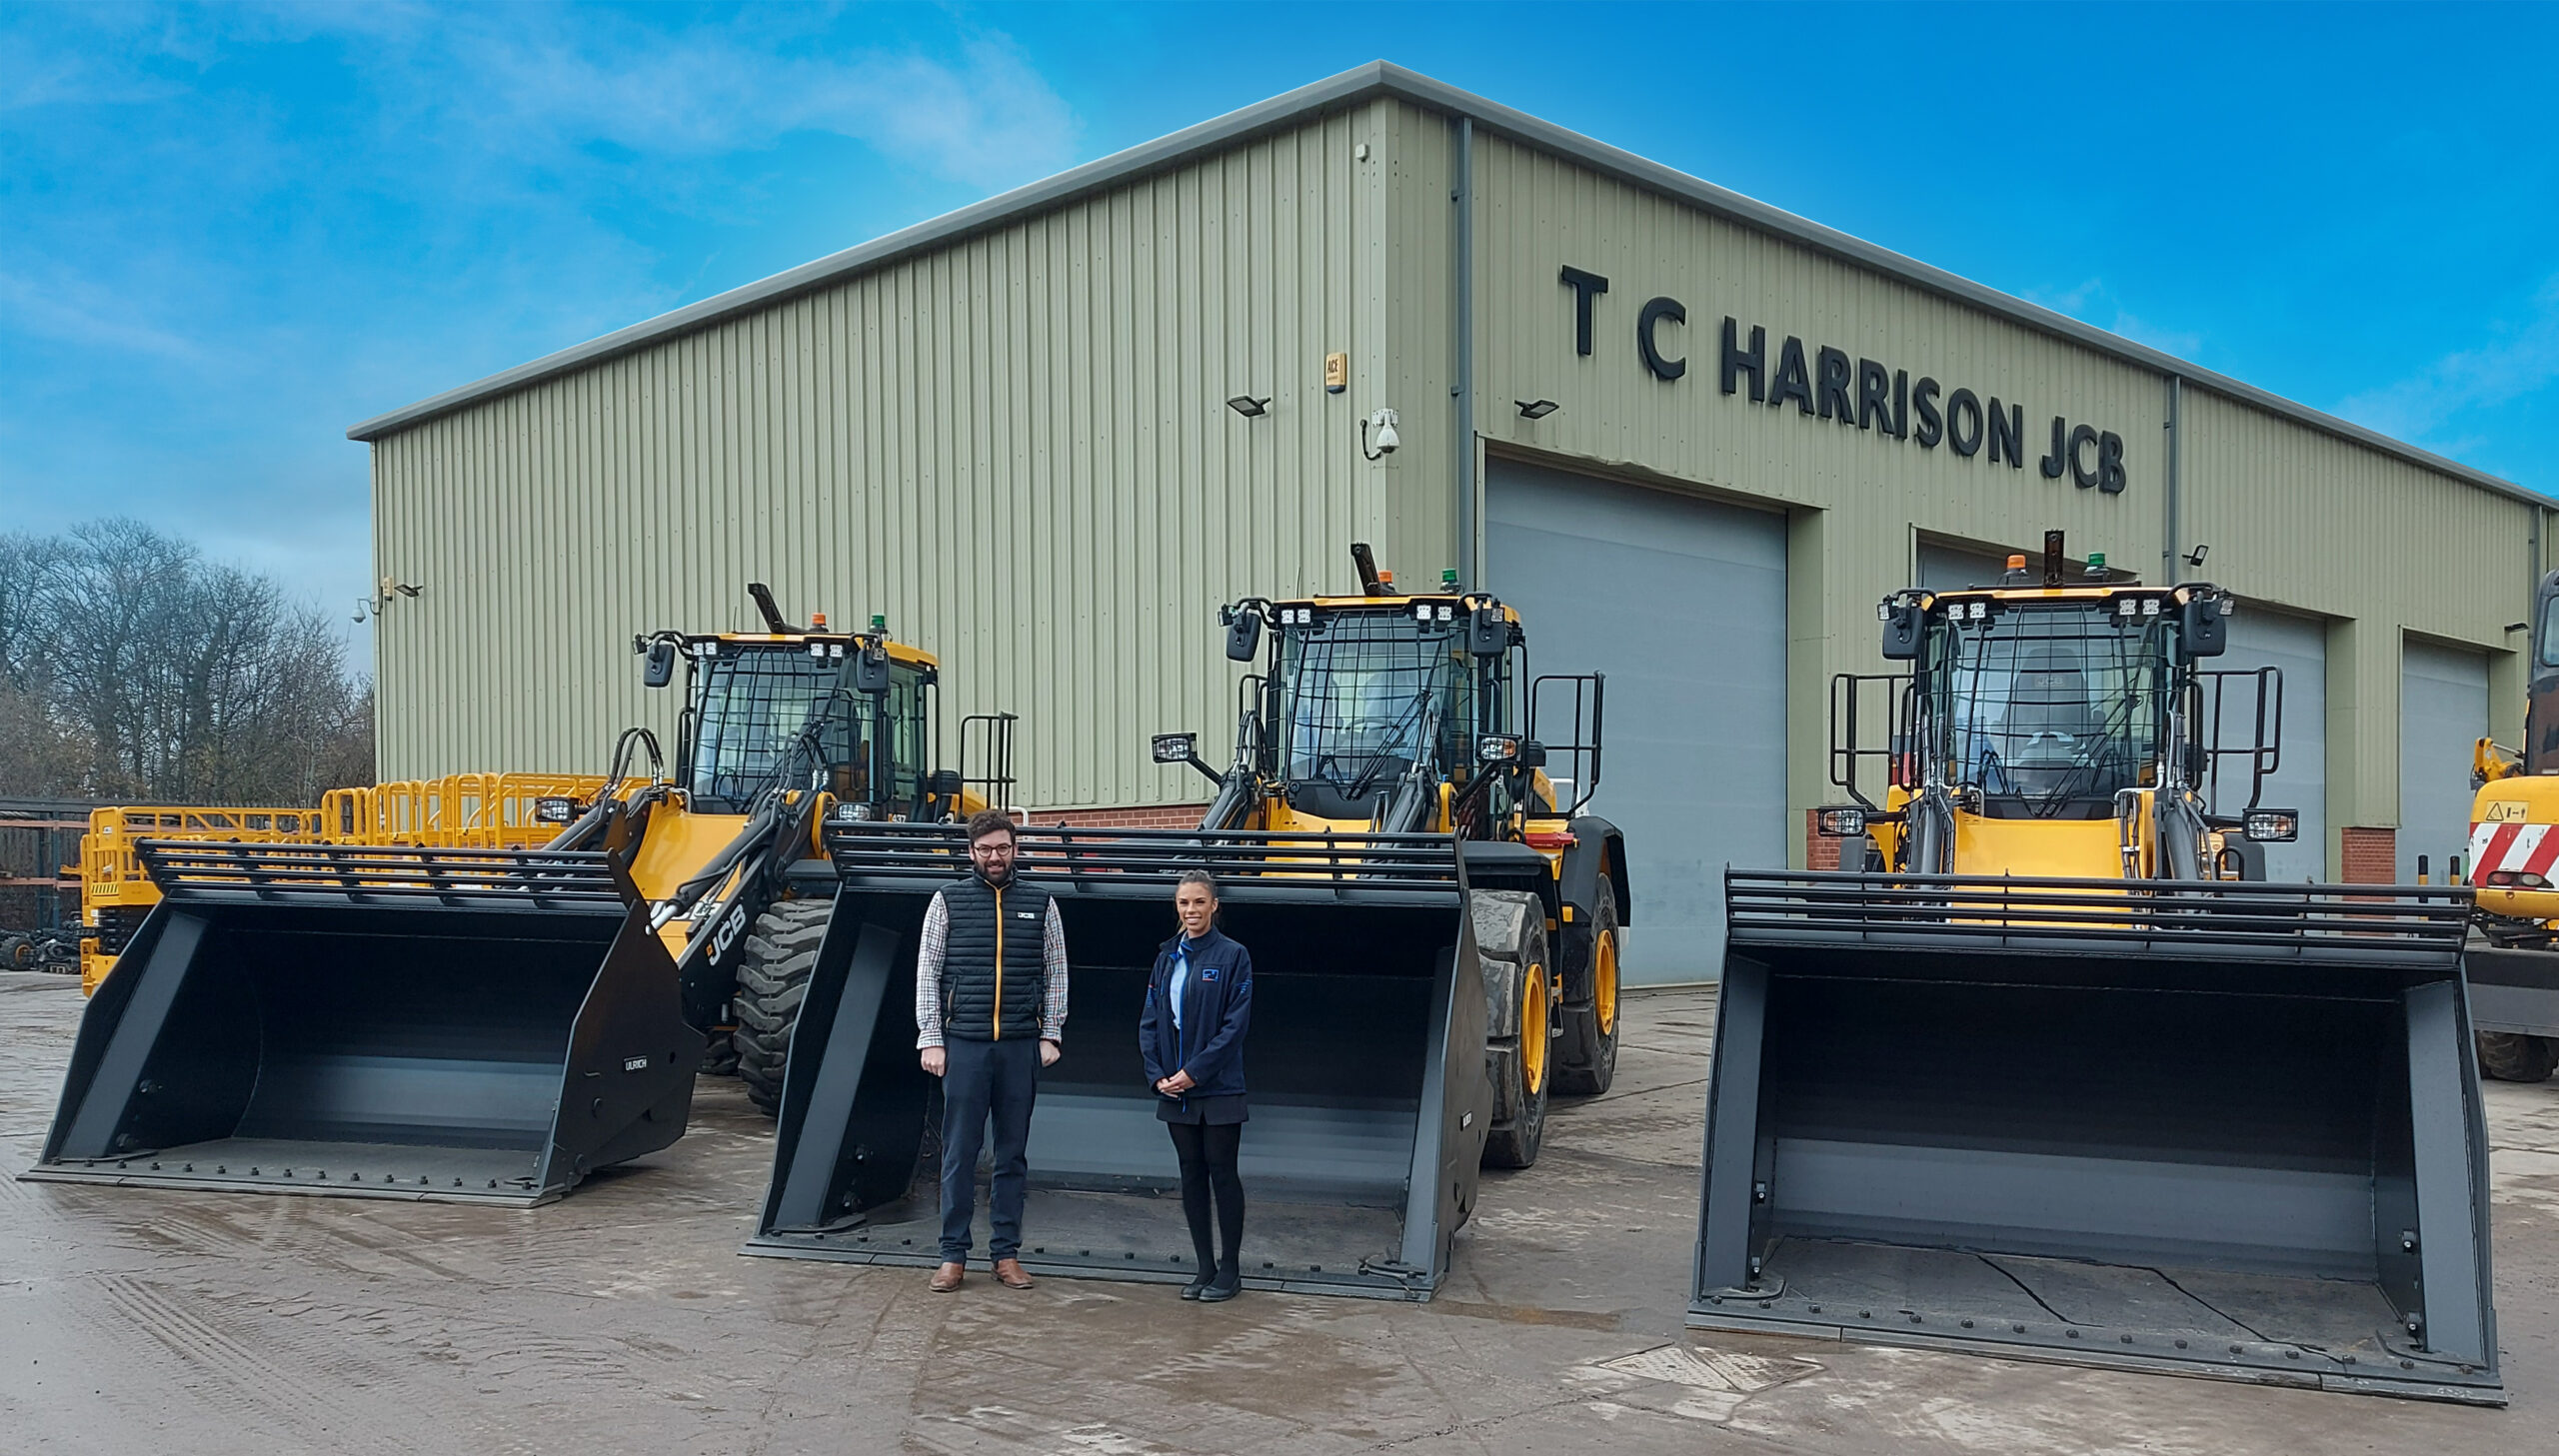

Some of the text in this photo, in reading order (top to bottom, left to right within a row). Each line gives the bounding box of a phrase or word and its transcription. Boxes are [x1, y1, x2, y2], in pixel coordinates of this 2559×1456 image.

[1327, 359, 1338, 374] ACE
[1560, 265, 2127, 496] T C HARRISON JCB
[709, 904, 747, 966] JCB
[626, 1059, 647, 1070] ULRICH
